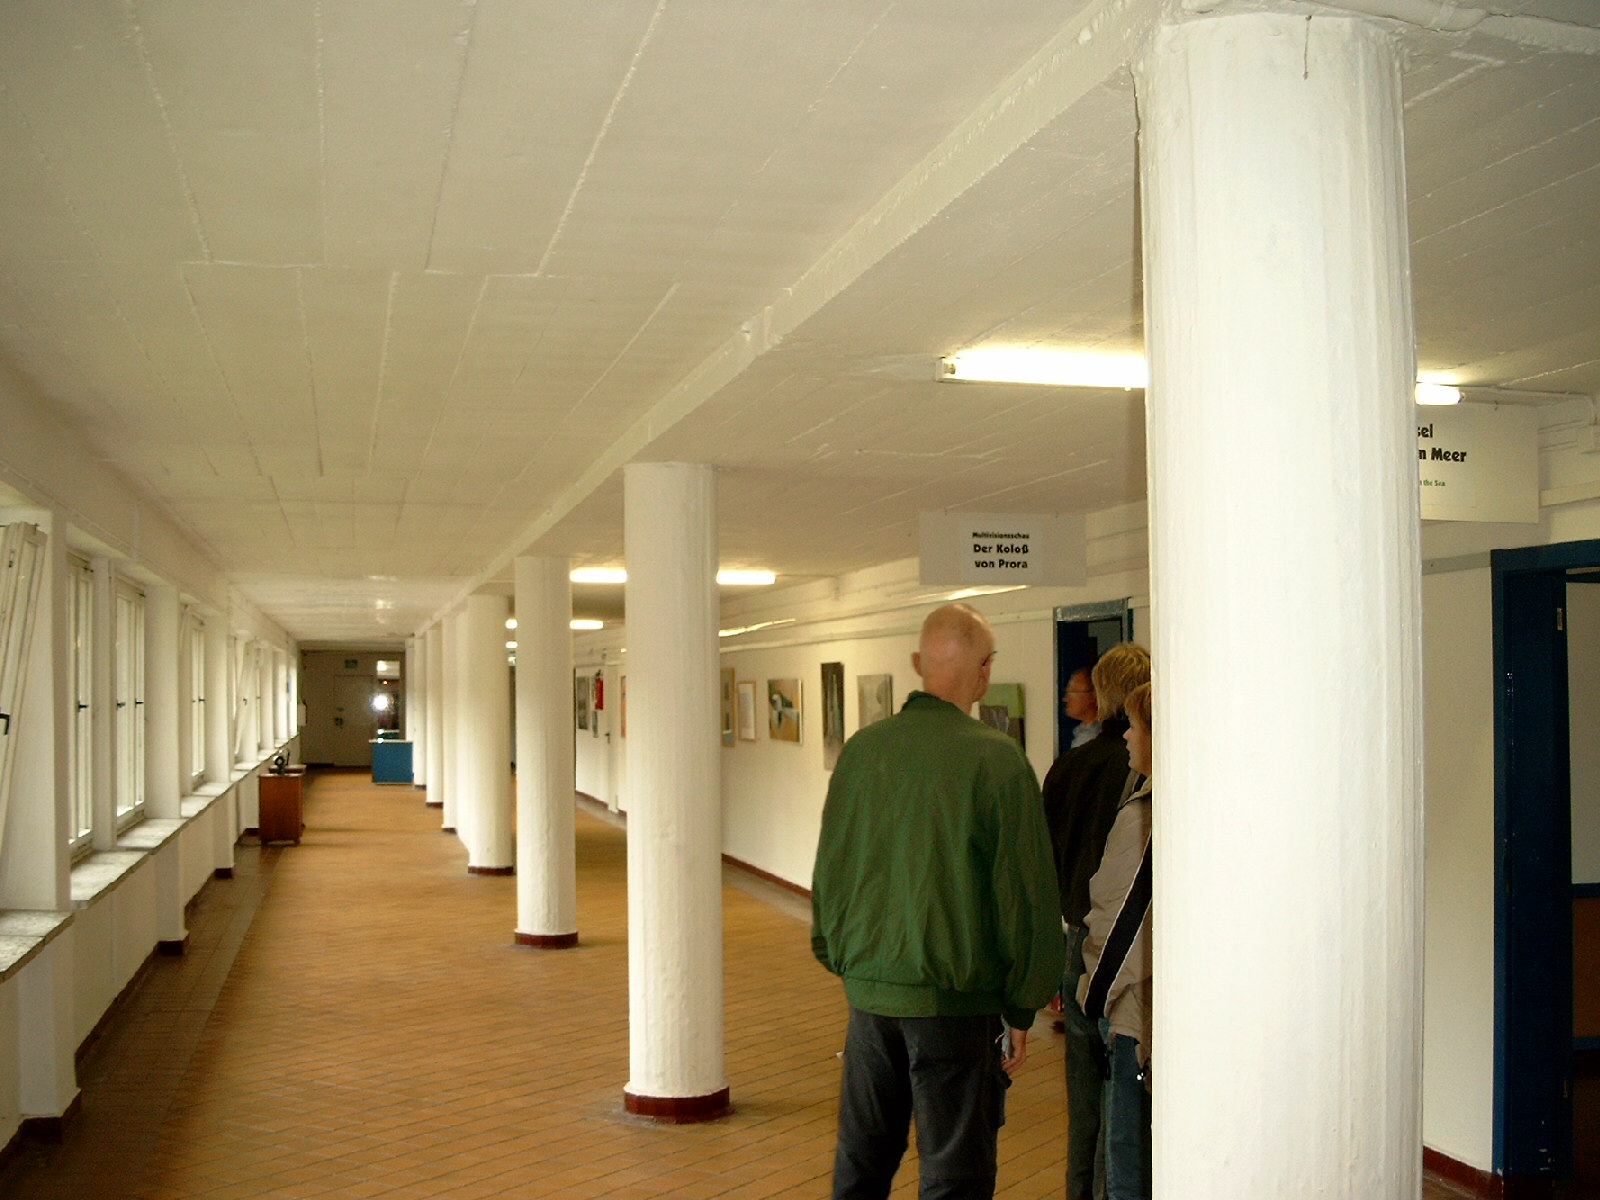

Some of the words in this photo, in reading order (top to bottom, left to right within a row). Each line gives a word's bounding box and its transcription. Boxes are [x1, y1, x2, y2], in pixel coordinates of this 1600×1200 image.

[1430, 447, 1467, 462] Meer
[973, 544, 993, 553] Der
[996, 544, 1029, 554] Koloß
[974, 560, 995, 568] von
[998, 559, 1028, 569] Prora
